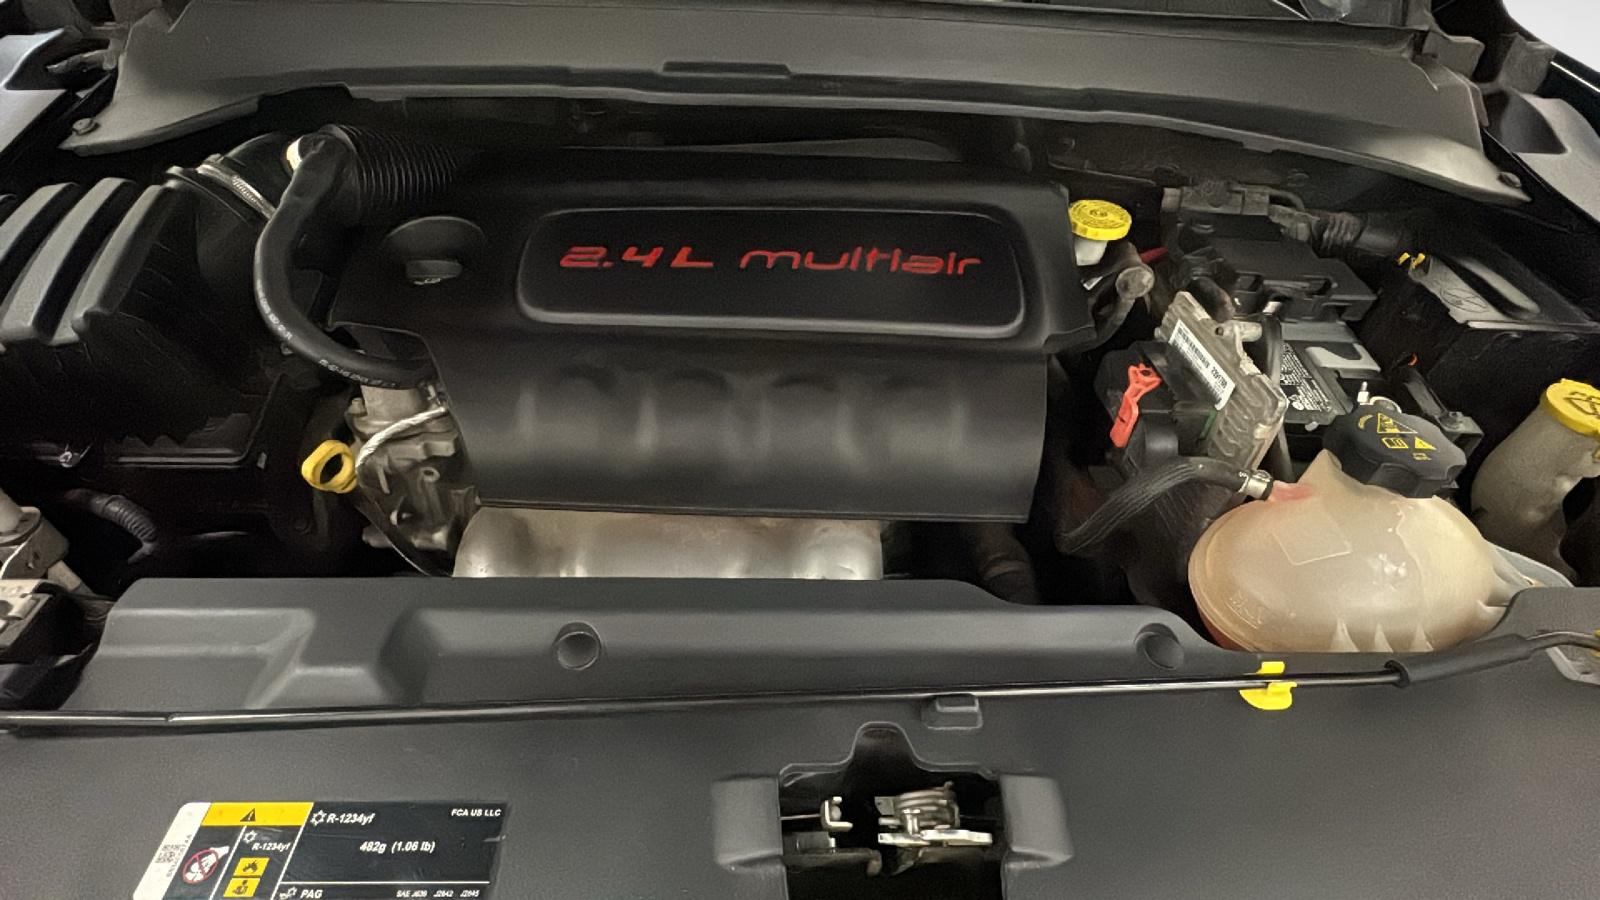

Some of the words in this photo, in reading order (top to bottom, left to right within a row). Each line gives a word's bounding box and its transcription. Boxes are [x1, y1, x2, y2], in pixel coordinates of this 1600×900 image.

[450, 808, 468, 817] FCA
[470, 808, 482, 817] US
[484, 808, 502, 817] LLC
[326, 812, 376, 826] R-1234yf
[251, 841, 291, 852] R-1234yf
[360, 841, 387, 854] 482g
[420, 841, 436, 854] lb)
[300, 889, 323, 899] PAG
[396, 889, 411, 898] SAE
